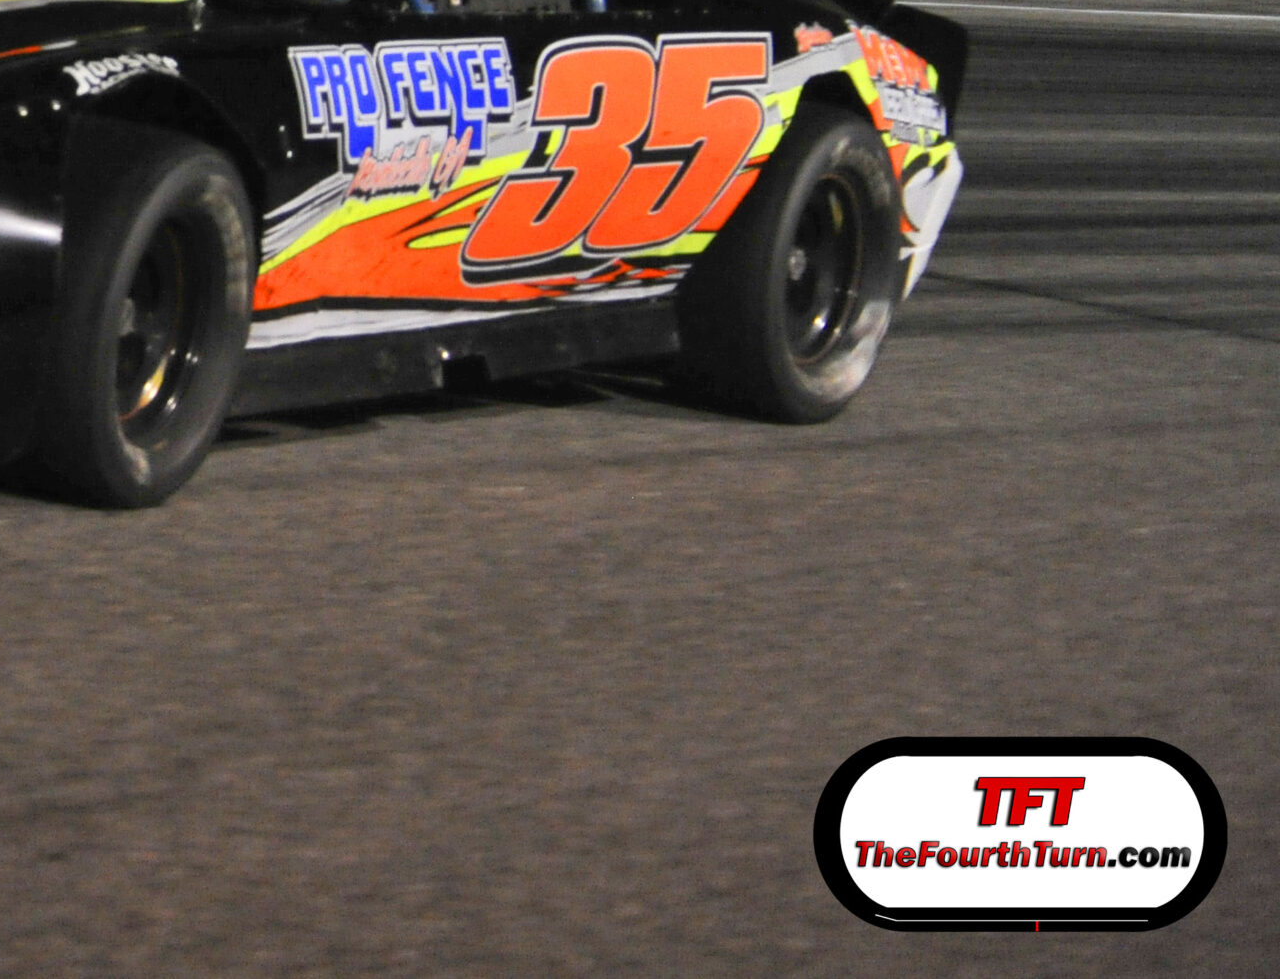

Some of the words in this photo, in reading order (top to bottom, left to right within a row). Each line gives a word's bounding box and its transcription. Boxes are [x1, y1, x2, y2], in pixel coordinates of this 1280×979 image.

[297, 51, 379, 162] PRO
[380, 44, 513, 153] FENCE
[460, 34, 770, 278] 35
